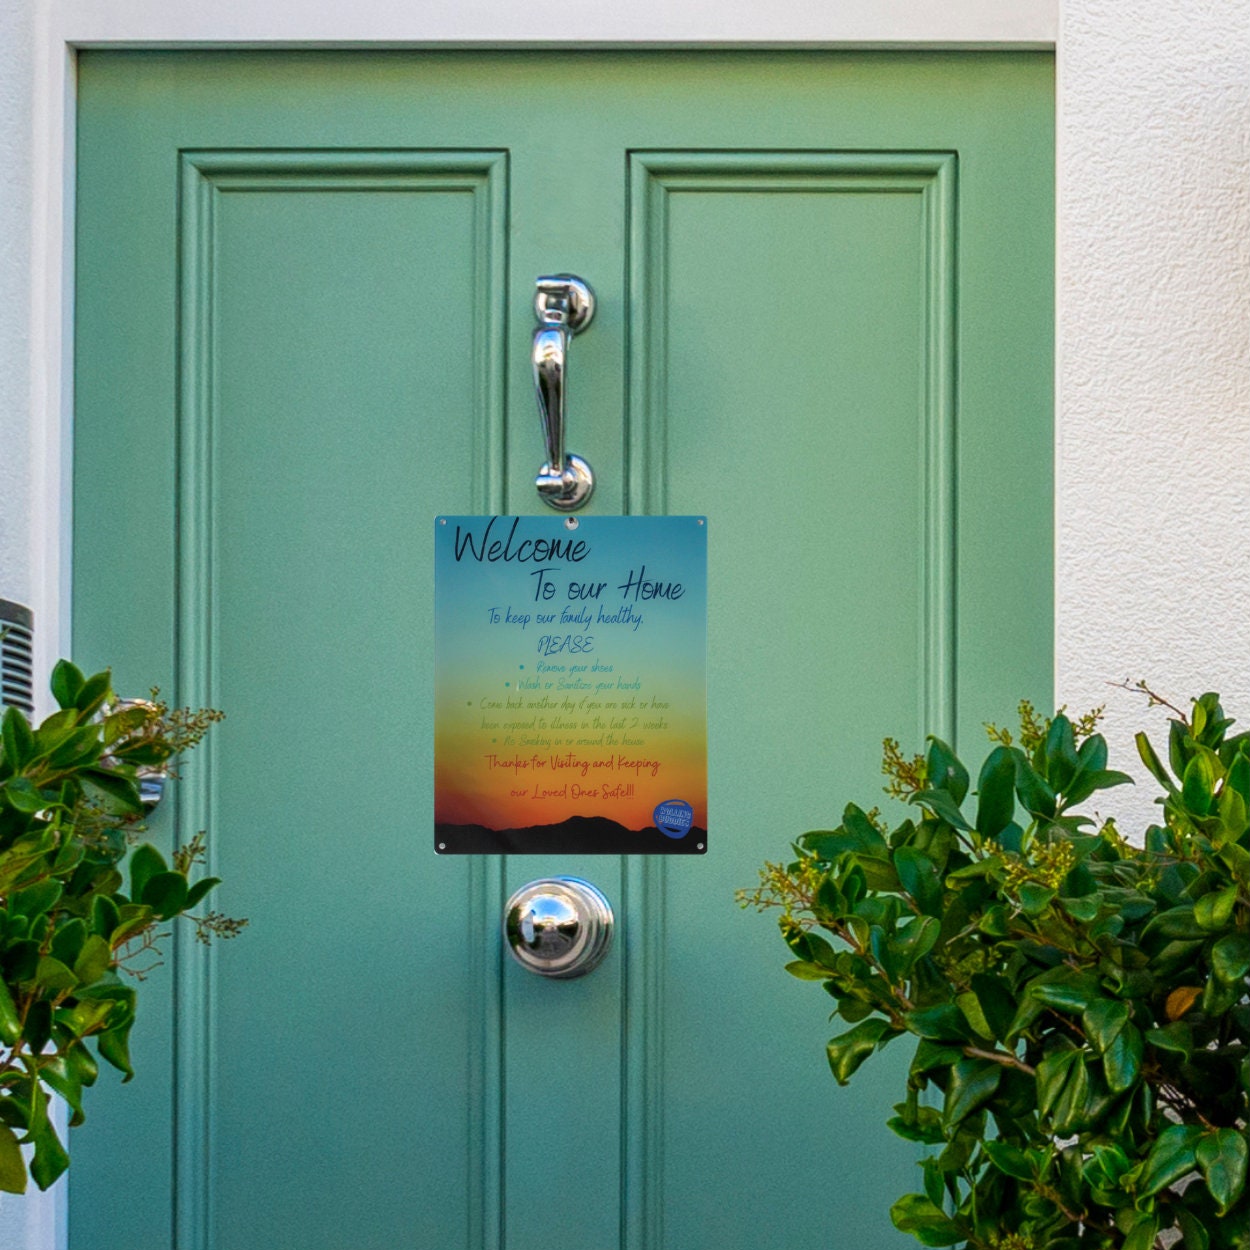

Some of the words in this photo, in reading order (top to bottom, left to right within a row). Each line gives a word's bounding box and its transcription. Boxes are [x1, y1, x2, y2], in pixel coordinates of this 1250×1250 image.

[455, 516, 591, 562] Welcome
[531, 568, 560, 602] To
[568, 582, 607, 600] our
[618, 566, 686, 600] Home
[488, 607, 502, 624] To
[505, 606, 530, 629] keep
[537, 615, 556, 624] our
[560, 606, 592, 631] family
[538, 635, 594, 655] PLEASE
[536, 661, 566, 673] Remove
[569, 665, 588, 677] your
[591, 658, 613, 673] shoes
[519, 676, 540, 689] Wash
[557, 676, 592, 689] Sanitize
[596, 682, 613, 695] your
[617, 676, 640, 689] hands
[480, 697, 502, 709] Come
[506, 696, 523, 708] back
[527, 696, 558, 709] another
[561, 696, 575, 713] day
[587, 702, 601, 713] you
[622, 697, 635, 709] sick
[651, 695, 670, 709] have
[481, 717, 500, 729] been
[503, 717, 536, 732] exposed
[539, 719, 548, 729] to
[551, 717, 577, 729] illness
[581, 719, 589, 729] in
[593, 717, 607, 729] the
[610, 717, 627, 729] last
[629, 717, 639, 729] 2
[643, 717, 668, 729] weeks
[606, 735, 618, 745] the
[622, 734, 644, 745] house
[485, 753, 529, 776] Thanks
[531, 755, 547, 769] for
[551, 753, 590, 777] Visiting
[593, 754, 613, 770] and
[618, 754, 661, 777] Keeping
[510, 789, 528, 797] our
[531, 784, 567, 800] Loved
[572, 785, 598, 798] Ones
